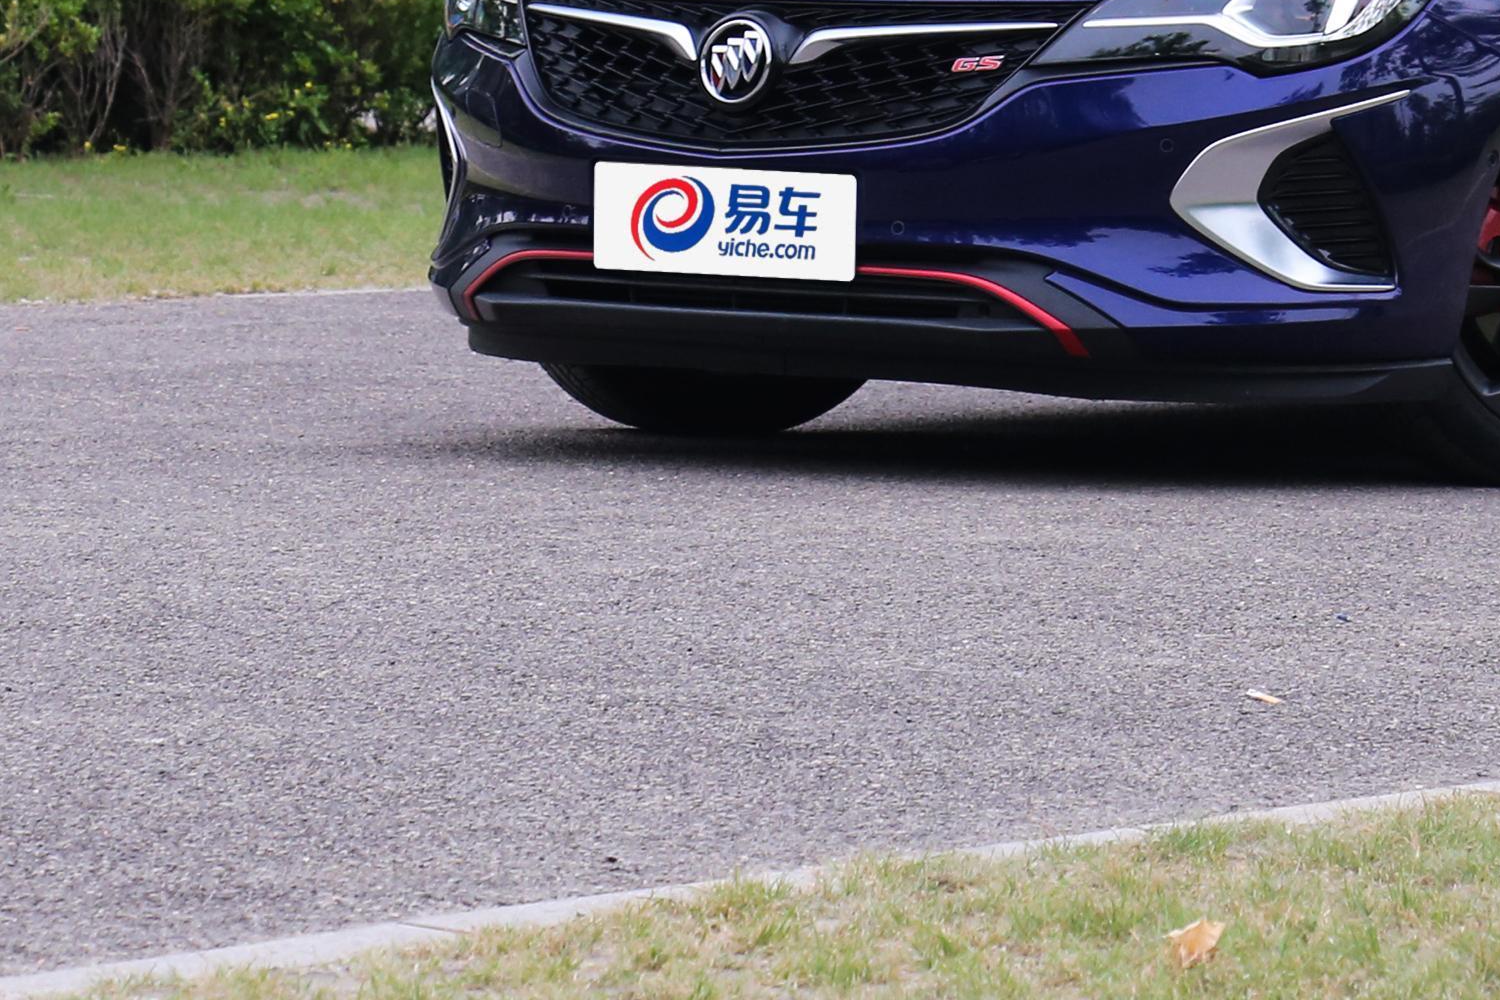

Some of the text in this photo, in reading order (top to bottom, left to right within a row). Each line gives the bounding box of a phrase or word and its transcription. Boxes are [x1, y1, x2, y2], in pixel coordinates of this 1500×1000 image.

[951, 55, 1005, 72] GS
[724, 183, 821, 238] 易车
[717, 238, 816, 260] yiche.com
